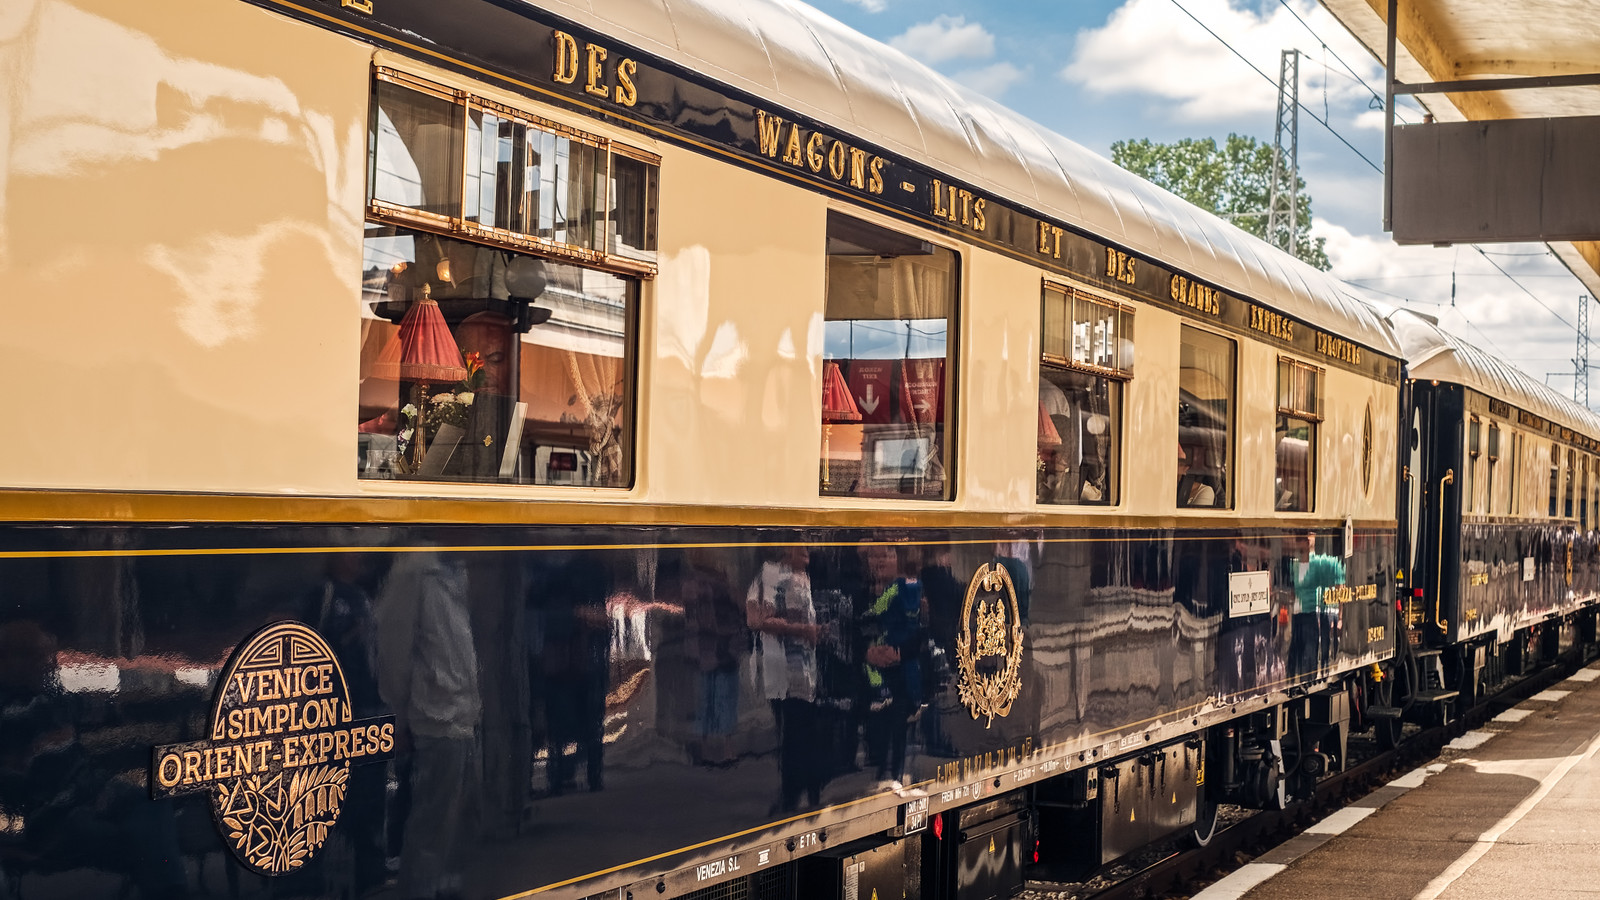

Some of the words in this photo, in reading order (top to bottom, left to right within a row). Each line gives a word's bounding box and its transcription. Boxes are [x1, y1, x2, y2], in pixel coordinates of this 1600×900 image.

[553, 30, 638, 107] DES
[756, 109, 883, 194] WAGONS
[931, 178, 986, 231] LITS
[1038, 221, 1063, 259] ET
[1106, 247, 1136, 285] DES
[1170, 274, 1220, 315] GRANDS
[1250, 304, 1293, 341] EXPRESS
[234, 664, 333, 703] VENICE
[228, 698, 338, 740] SIMPLON
[158, 723, 395, 787] ORIENT-EXPRESS
[696, 859, 726, 881] VENEZIA
